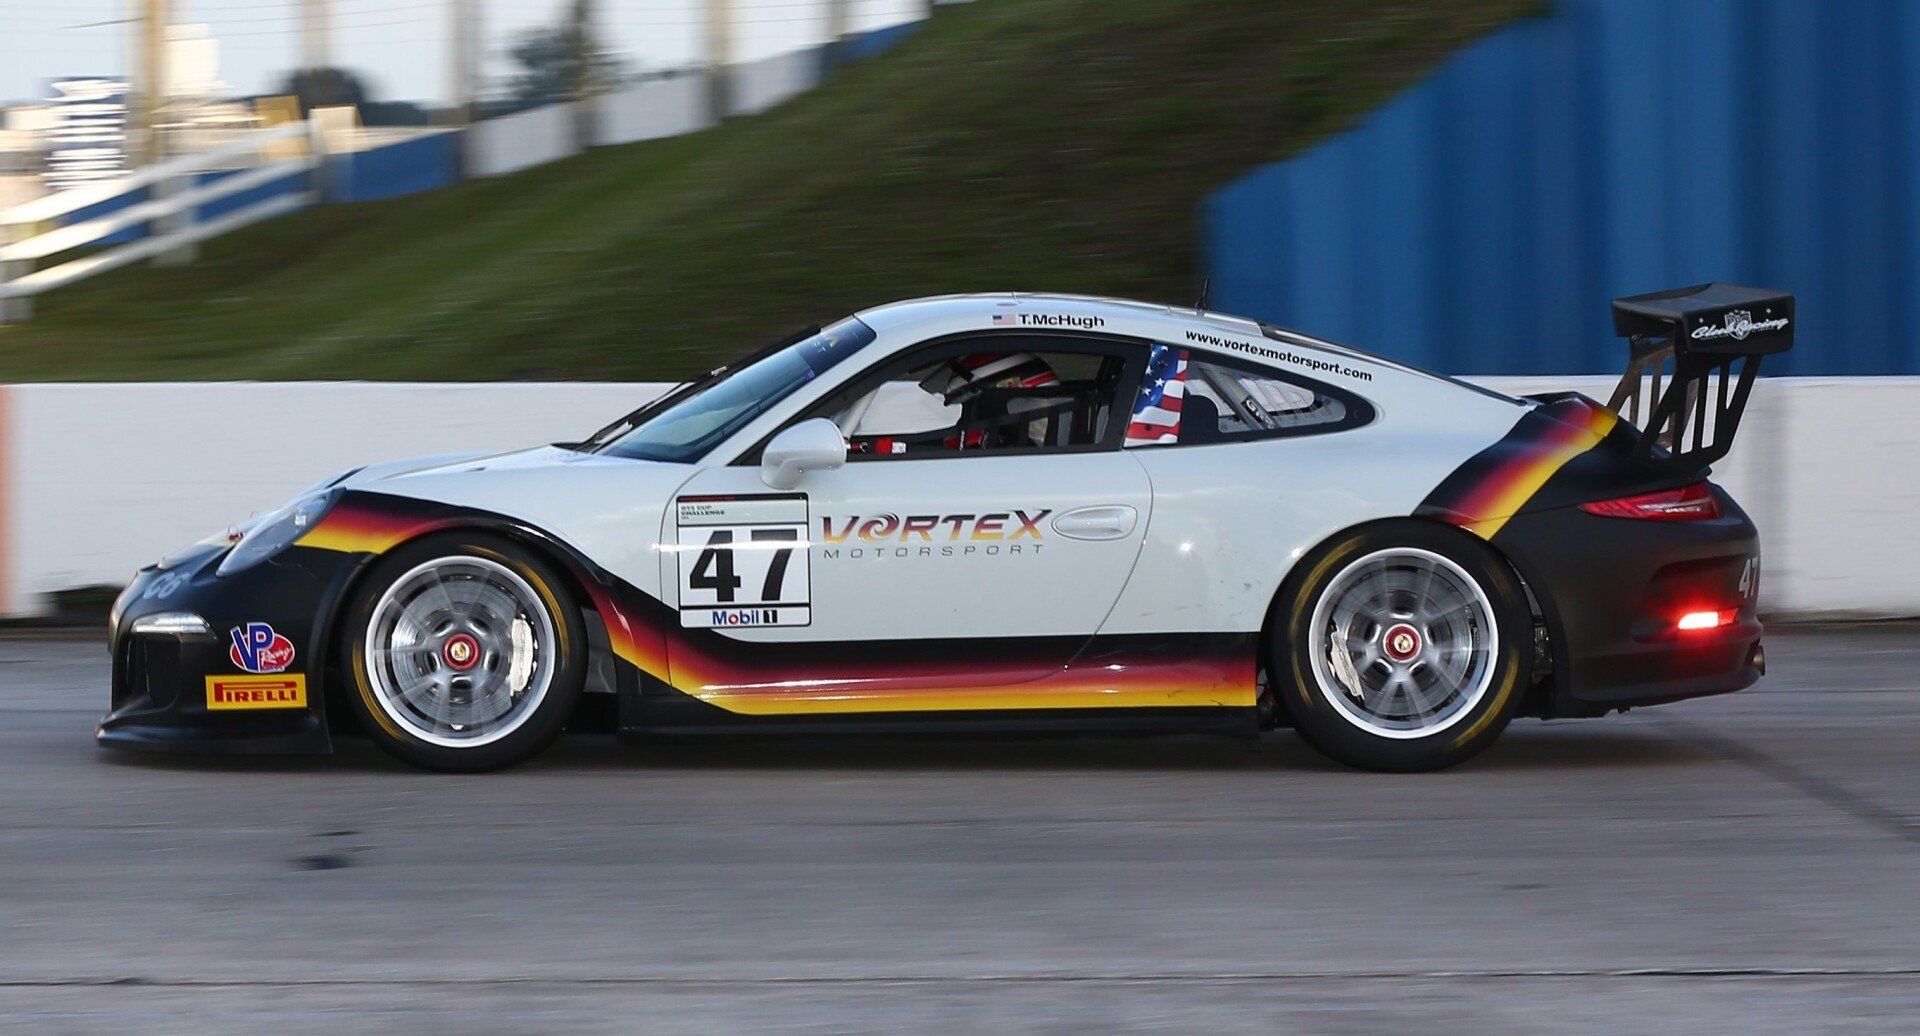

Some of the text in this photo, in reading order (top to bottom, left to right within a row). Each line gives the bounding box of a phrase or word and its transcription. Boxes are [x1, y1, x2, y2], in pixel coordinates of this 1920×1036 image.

[1018, 314, 1105, 329] T.McHugh
[1186, 330, 1372, 381] www.vortexmotorsport.com
[821, 509, 1052, 543] VORTEX
[689, 528, 798, 602] 47
[823, 544, 1044, 559] MOTORSPORT
[1739, 556, 1758, 598] 47
[712, 609, 778, 626] Mobil 1
[230, 622, 275, 673] VP
[214, 681, 298, 702] PIRELLI
